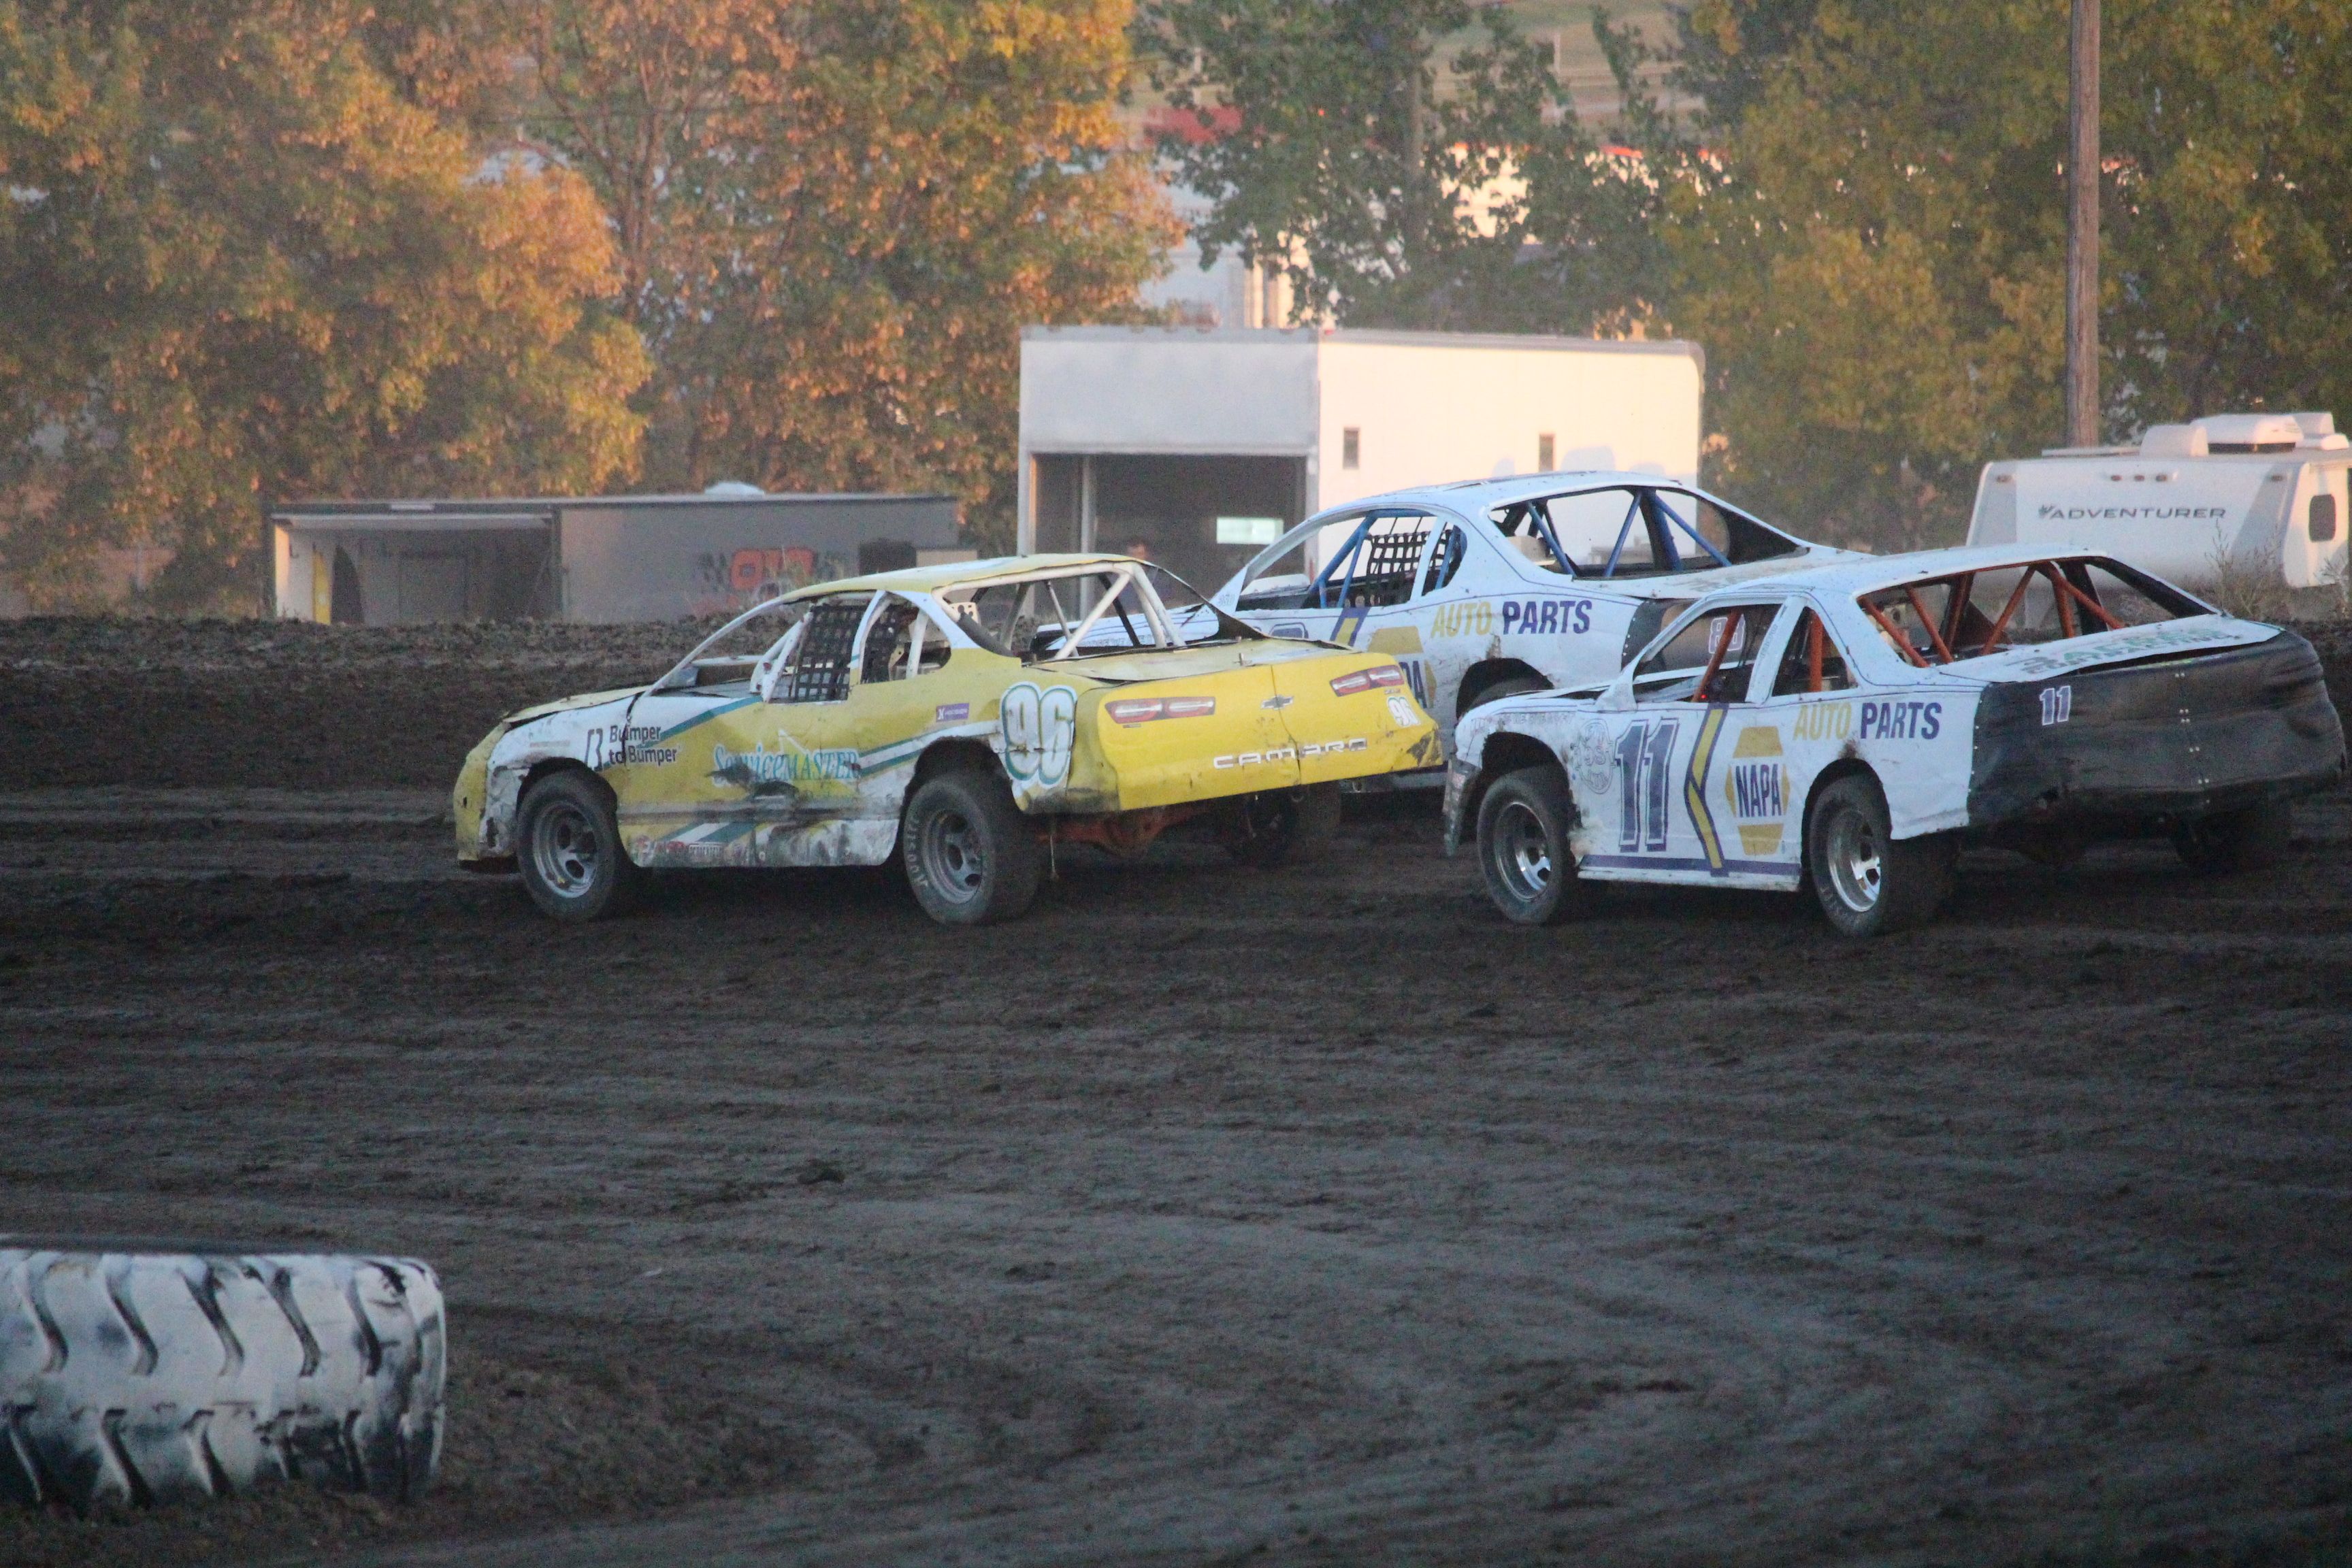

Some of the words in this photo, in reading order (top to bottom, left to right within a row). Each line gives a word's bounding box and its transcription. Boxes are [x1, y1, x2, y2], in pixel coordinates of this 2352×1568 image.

[2050, 506, 2226, 520] ADVENTURER
[1431, 602, 1492, 638] AUTO
[1502, 600, 1592, 635] PARTS
[1387, 696, 1420, 727] 96
[1793, 702, 1852, 740] AUTO
[1860, 702, 1942, 740] PARTS
[2040, 685, 2071, 725] 11
[610, 725, 661, 743] Bumper
[1000, 683, 1077, 784] 96
[609, 749, 625, 765] to
[627, 745, 677, 766] Bumper
[1213, 738, 1367, 769] CAMARO
[1614, 717, 1680, 853] 11
[1735, 764, 1782, 817] NAPA
